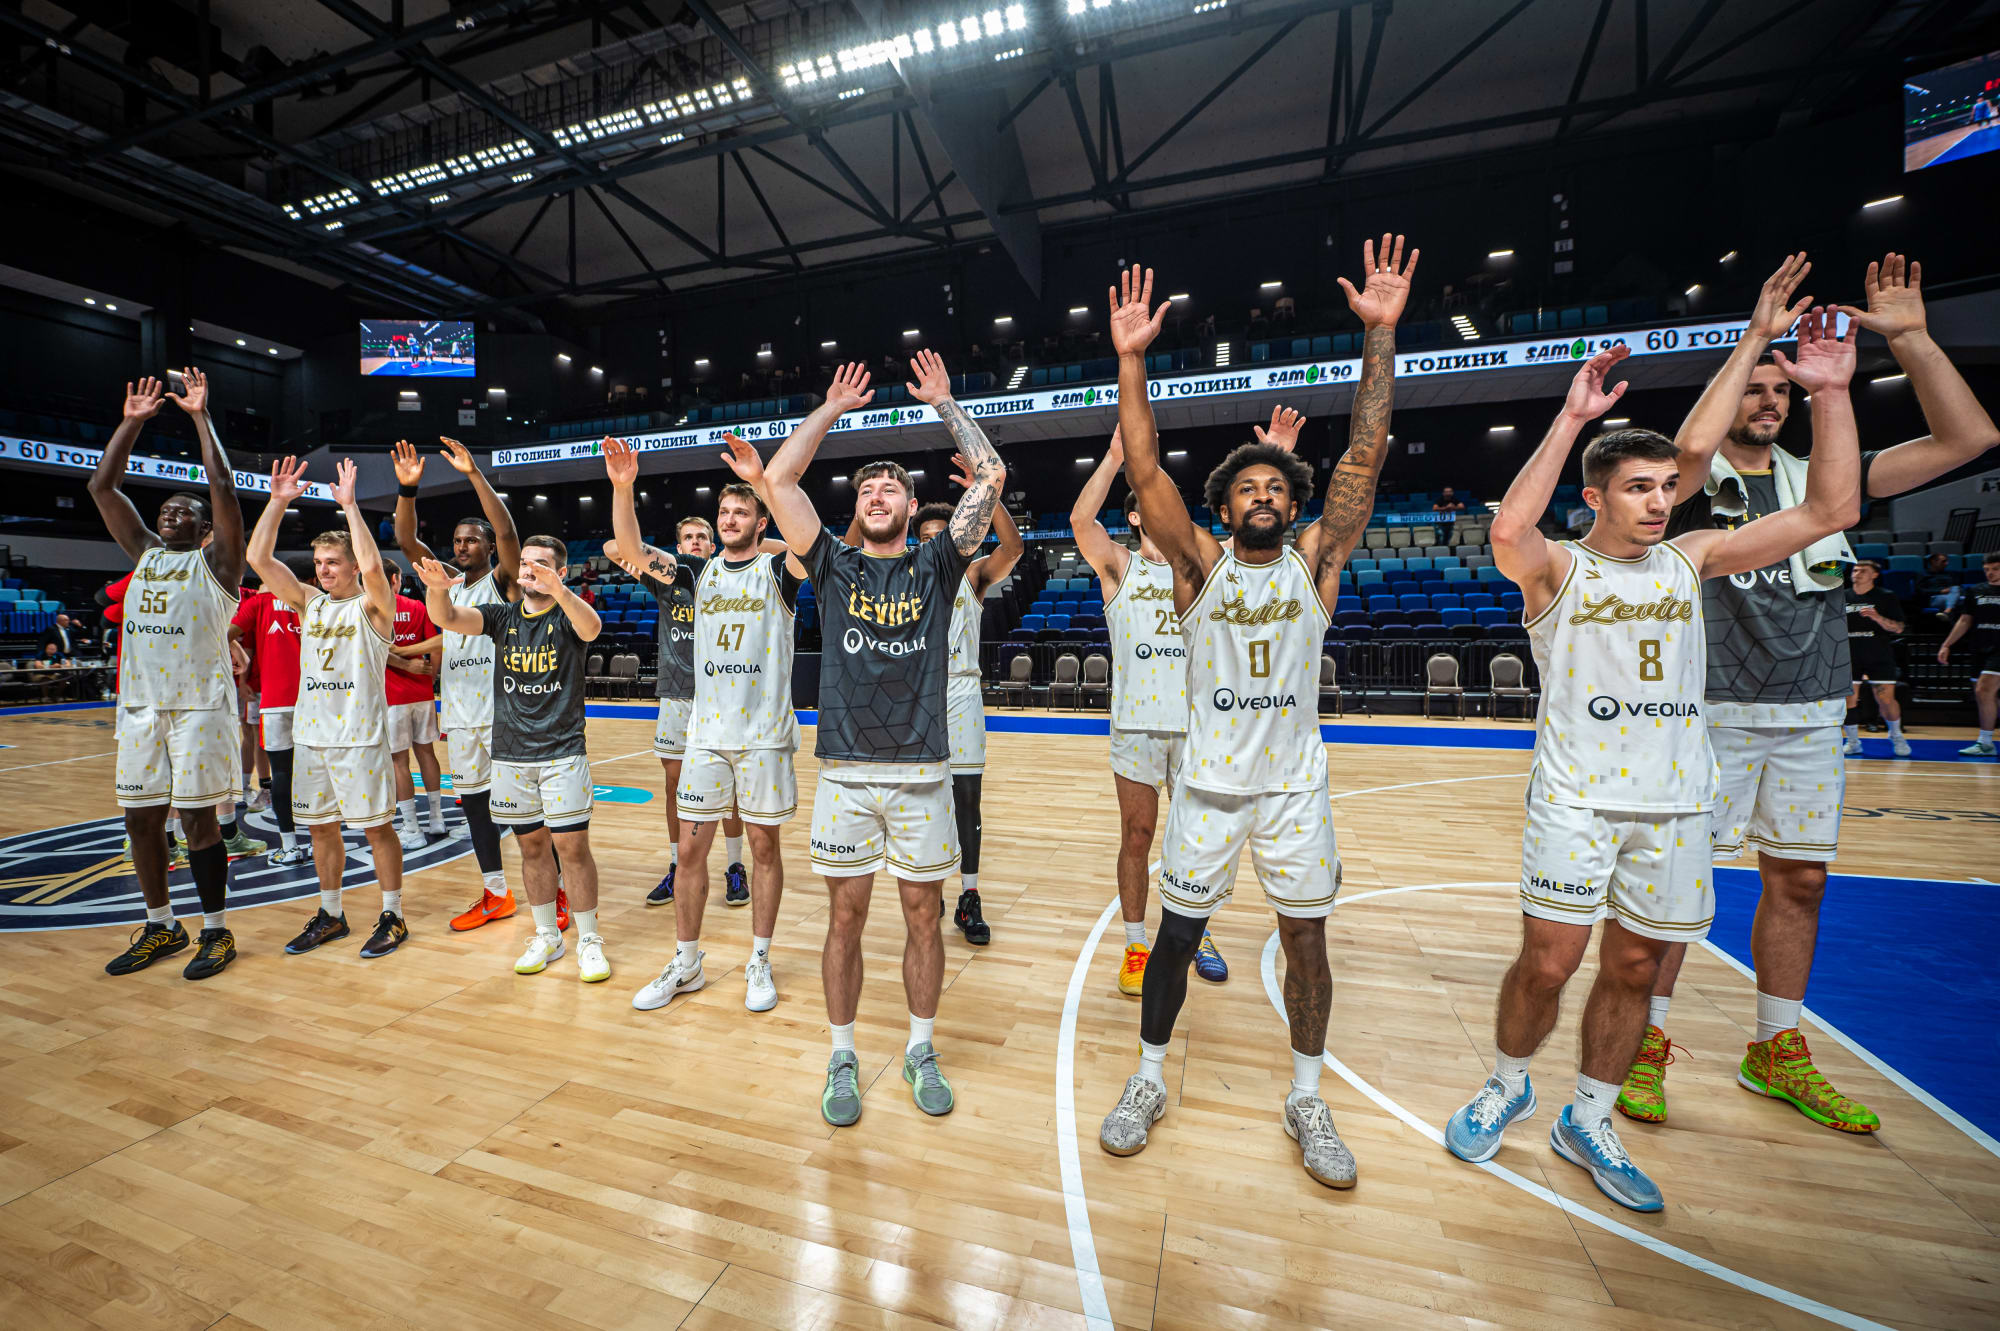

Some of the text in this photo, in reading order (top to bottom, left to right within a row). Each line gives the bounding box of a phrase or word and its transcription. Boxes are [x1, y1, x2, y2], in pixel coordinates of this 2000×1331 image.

[498, 450, 512, 464] 60
[515, 448, 561, 463] години
[627, 437, 642, 451] 60
[645, 434, 698, 450] години
[768, 421, 786, 437] 60
[1167, 375, 1252, 397] години
[1404, 349, 1508, 374] години
[1646, 329, 1680, 351] 60
[20, 439, 48, 460] 60
[235, 472, 254, 488] 60
[139, 588, 168, 614] 55
[700, 594, 766, 616] Levice
[848, 590, 924, 627] LEVICE
[1569, 593, 1694, 626] Levice
[1209, 597, 1304, 627] Levice
[137, 623, 186, 636] VEOLIA
[716, 623, 746, 652] 47
[865, 636, 927, 656] VEOLIA
[454, 656, 492, 669] VEOLIA
[717, 664, 762, 674] VEOLIA
[1248, 639, 1271, 678] 0
[1638, 639, 1664, 682] 8
[314, 681, 355, 691] VEOLIA
[518, 681, 563, 695] VEOLIA
[1237, 694, 1297, 710] VEOLIA
[1625, 702, 1699, 717] VEOLIA
[116, 783, 143, 791] ALEON
[811, 838, 856, 853] HALEON
[1162, 869, 1210, 895] HALEON
[1530, 875, 1597, 896] HALEON
